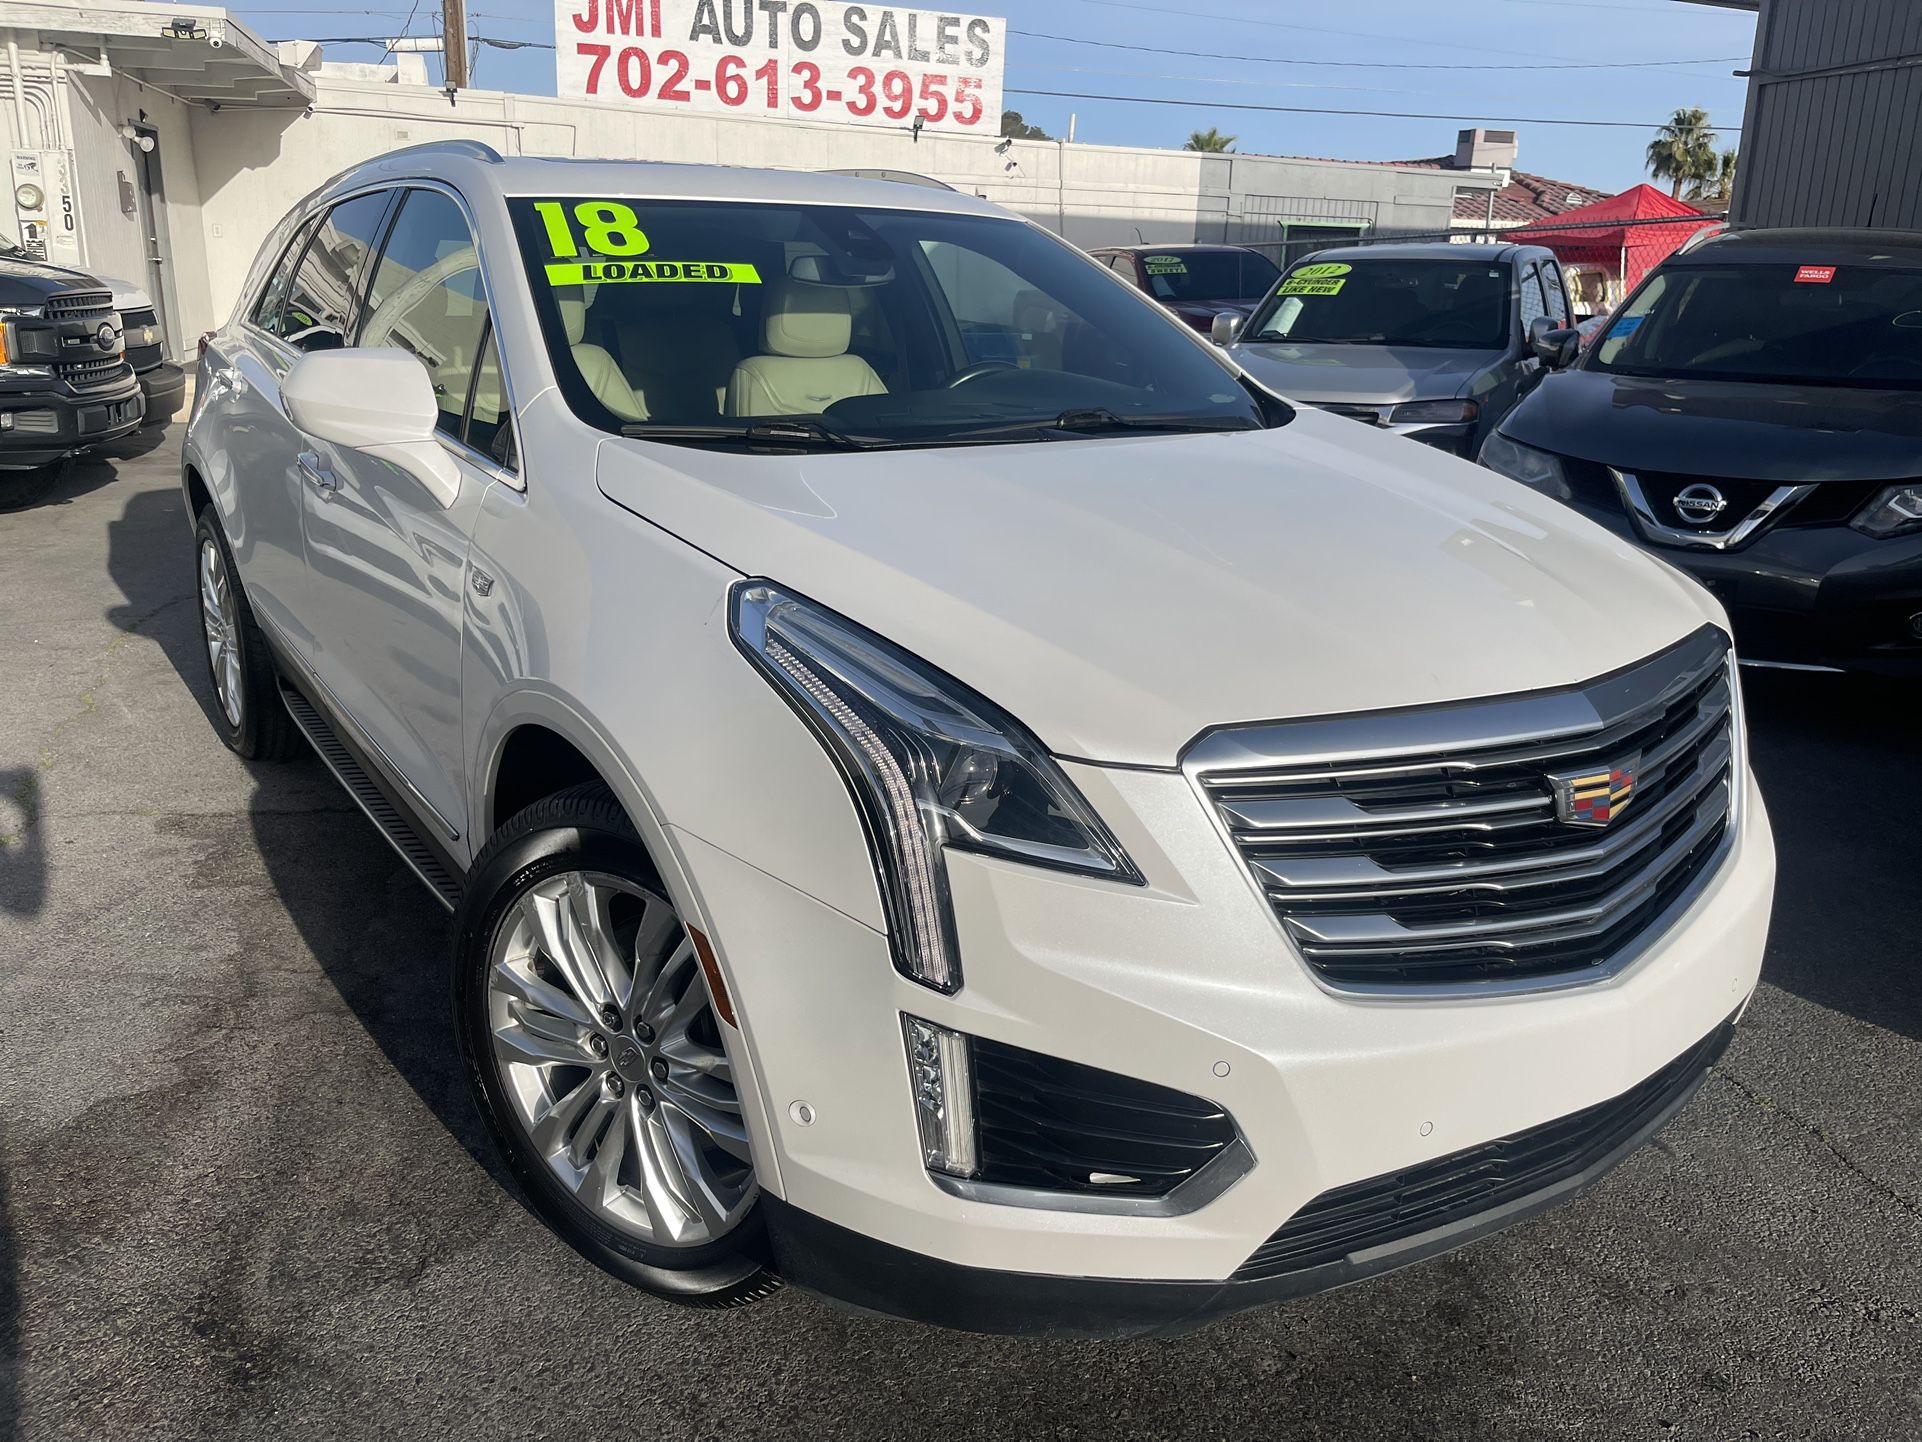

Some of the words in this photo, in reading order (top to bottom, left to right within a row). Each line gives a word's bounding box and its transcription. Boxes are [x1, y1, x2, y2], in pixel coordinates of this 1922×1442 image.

[572, 0, 662, 38] JMI
[690, 0, 822, 52] AUTO
[842, 5, 991, 68] SALES
[576, 42, 984, 126] 702-613-3955
[533, 201, 650, 257] 18
[582, 263, 734, 282] LOADED
[1300, 265, 1342, 277] 2012
[1679, 500, 1719, 509] NISSAN
